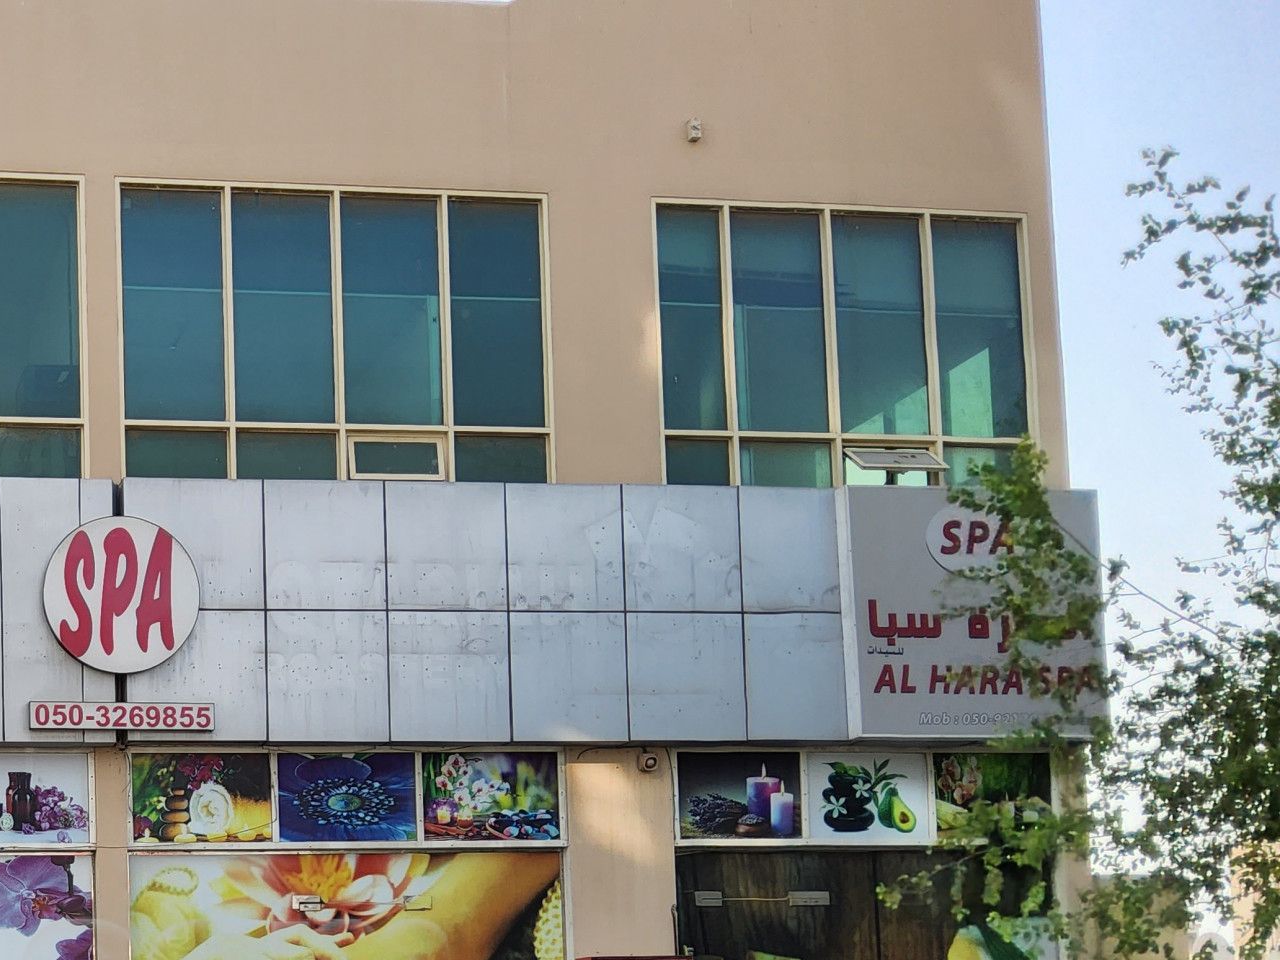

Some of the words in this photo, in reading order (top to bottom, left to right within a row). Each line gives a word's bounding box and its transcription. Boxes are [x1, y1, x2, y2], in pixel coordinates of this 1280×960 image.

[59, 527, 175, 658] SPA
[873, 664, 916, 694] AL
[929, 664, 1023, 695] HARA
[34, 703, 212, 729] 050-3269855
